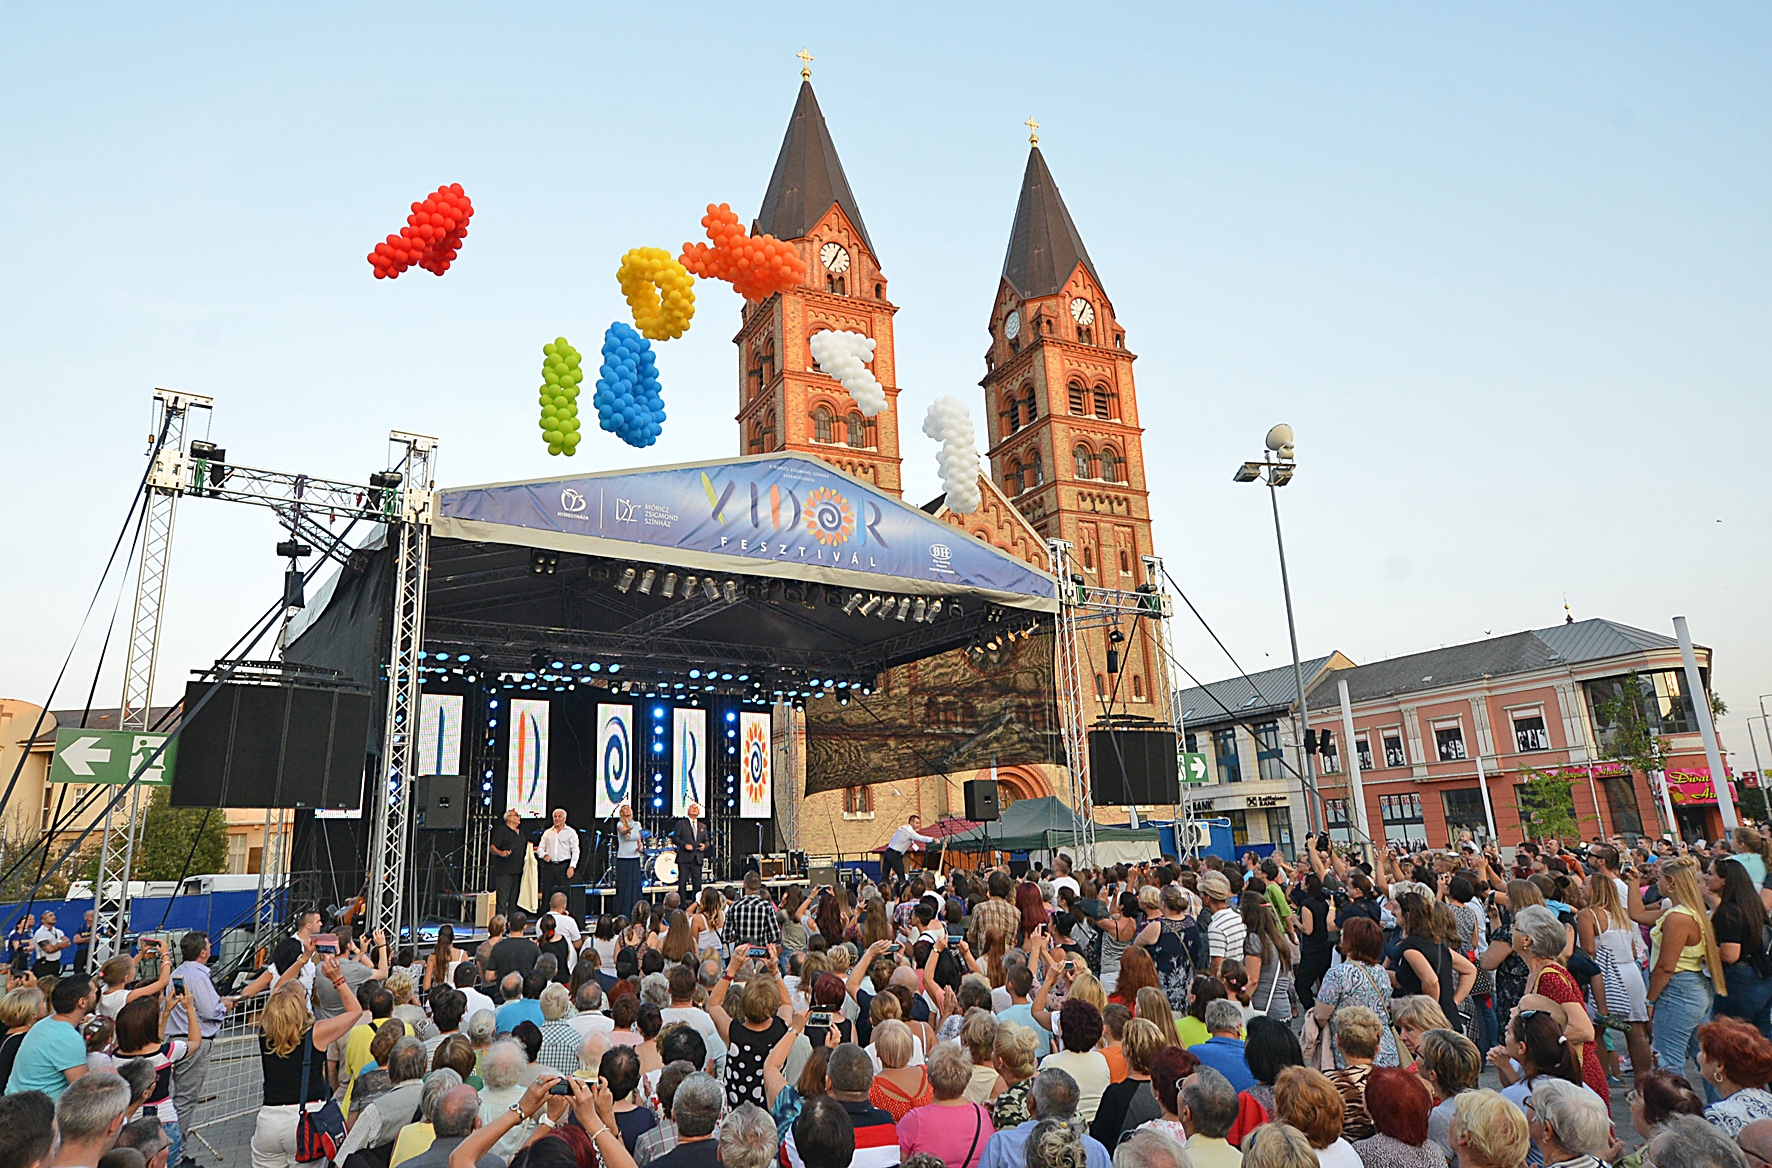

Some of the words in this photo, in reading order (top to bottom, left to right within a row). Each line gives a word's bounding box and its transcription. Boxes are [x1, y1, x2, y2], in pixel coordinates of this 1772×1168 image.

[644, 503, 670, 513] MÓRICZ
[644, 511, 679, 522] ZSIGMOND
[644, 518, 671, 528] SZÍNHÁZ
[720, 536, 877, 567] FESZTIVÁL
[1668, 771, 1710, 784] Divat
